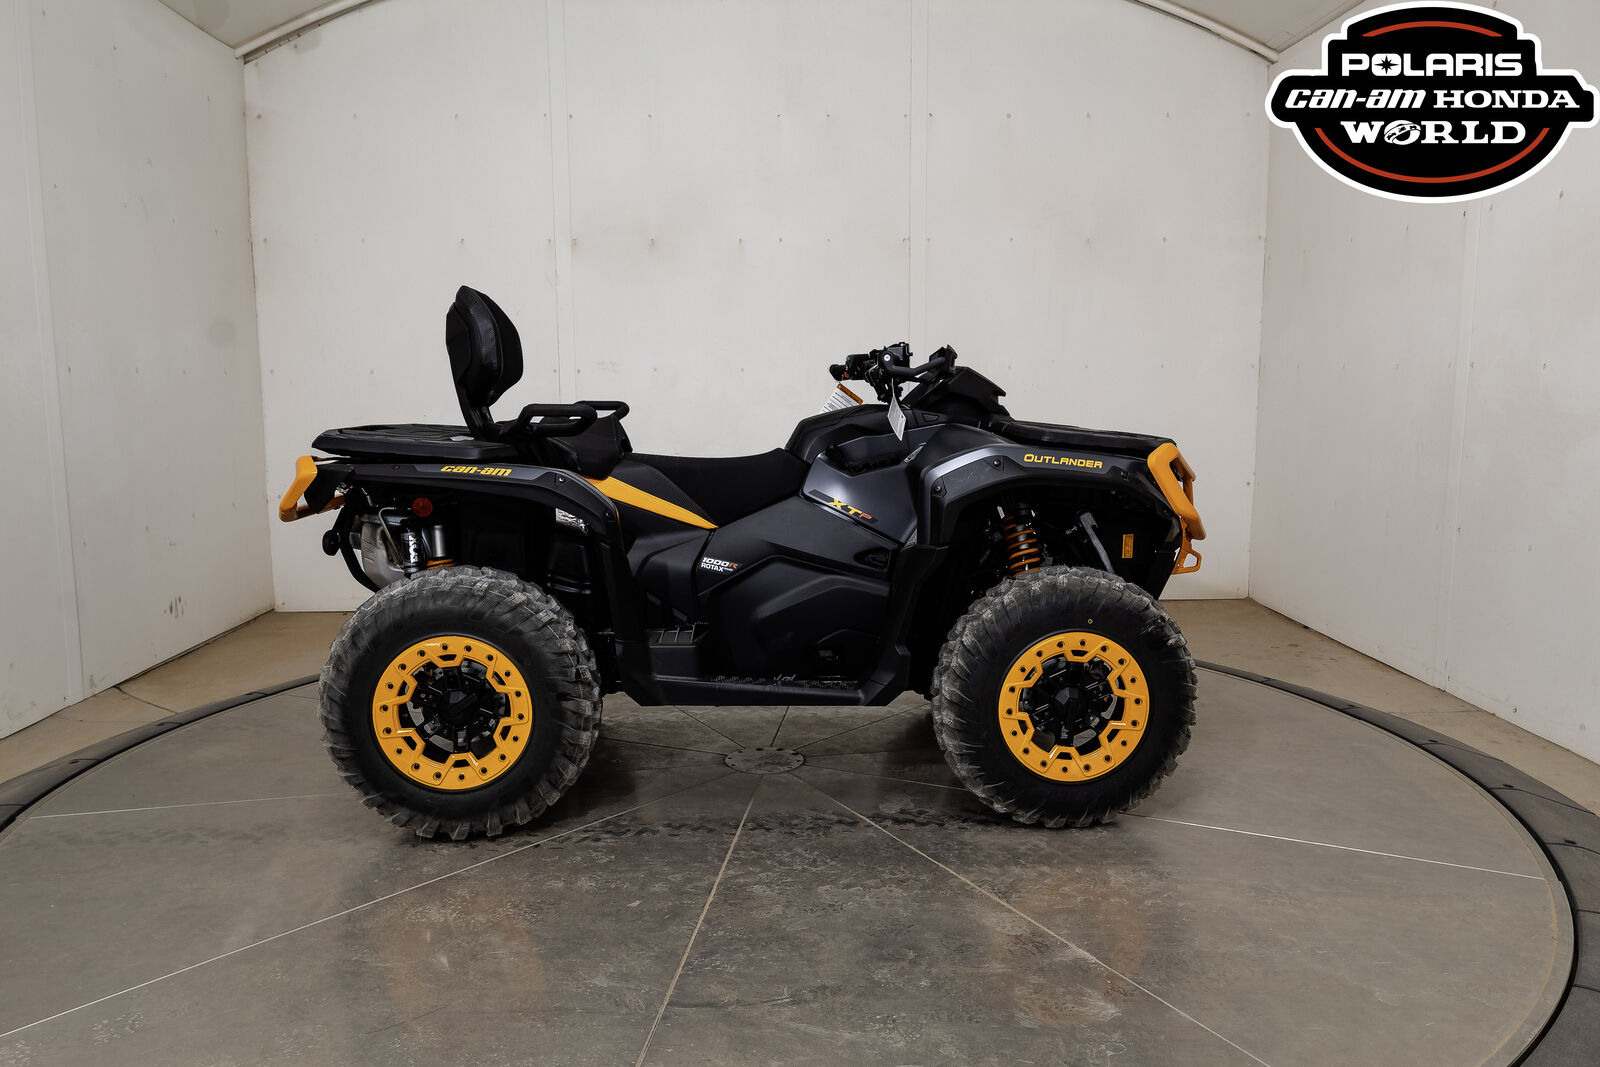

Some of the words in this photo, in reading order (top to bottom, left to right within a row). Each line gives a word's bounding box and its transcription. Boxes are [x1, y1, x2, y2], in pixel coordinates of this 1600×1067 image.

[1023, 453, 1103, 469] OUTLANDER
[440, 465, 512, 477] can-am
[828, 498, 872, 520] XTP
[701, 562, 724, 572] ROTAX
